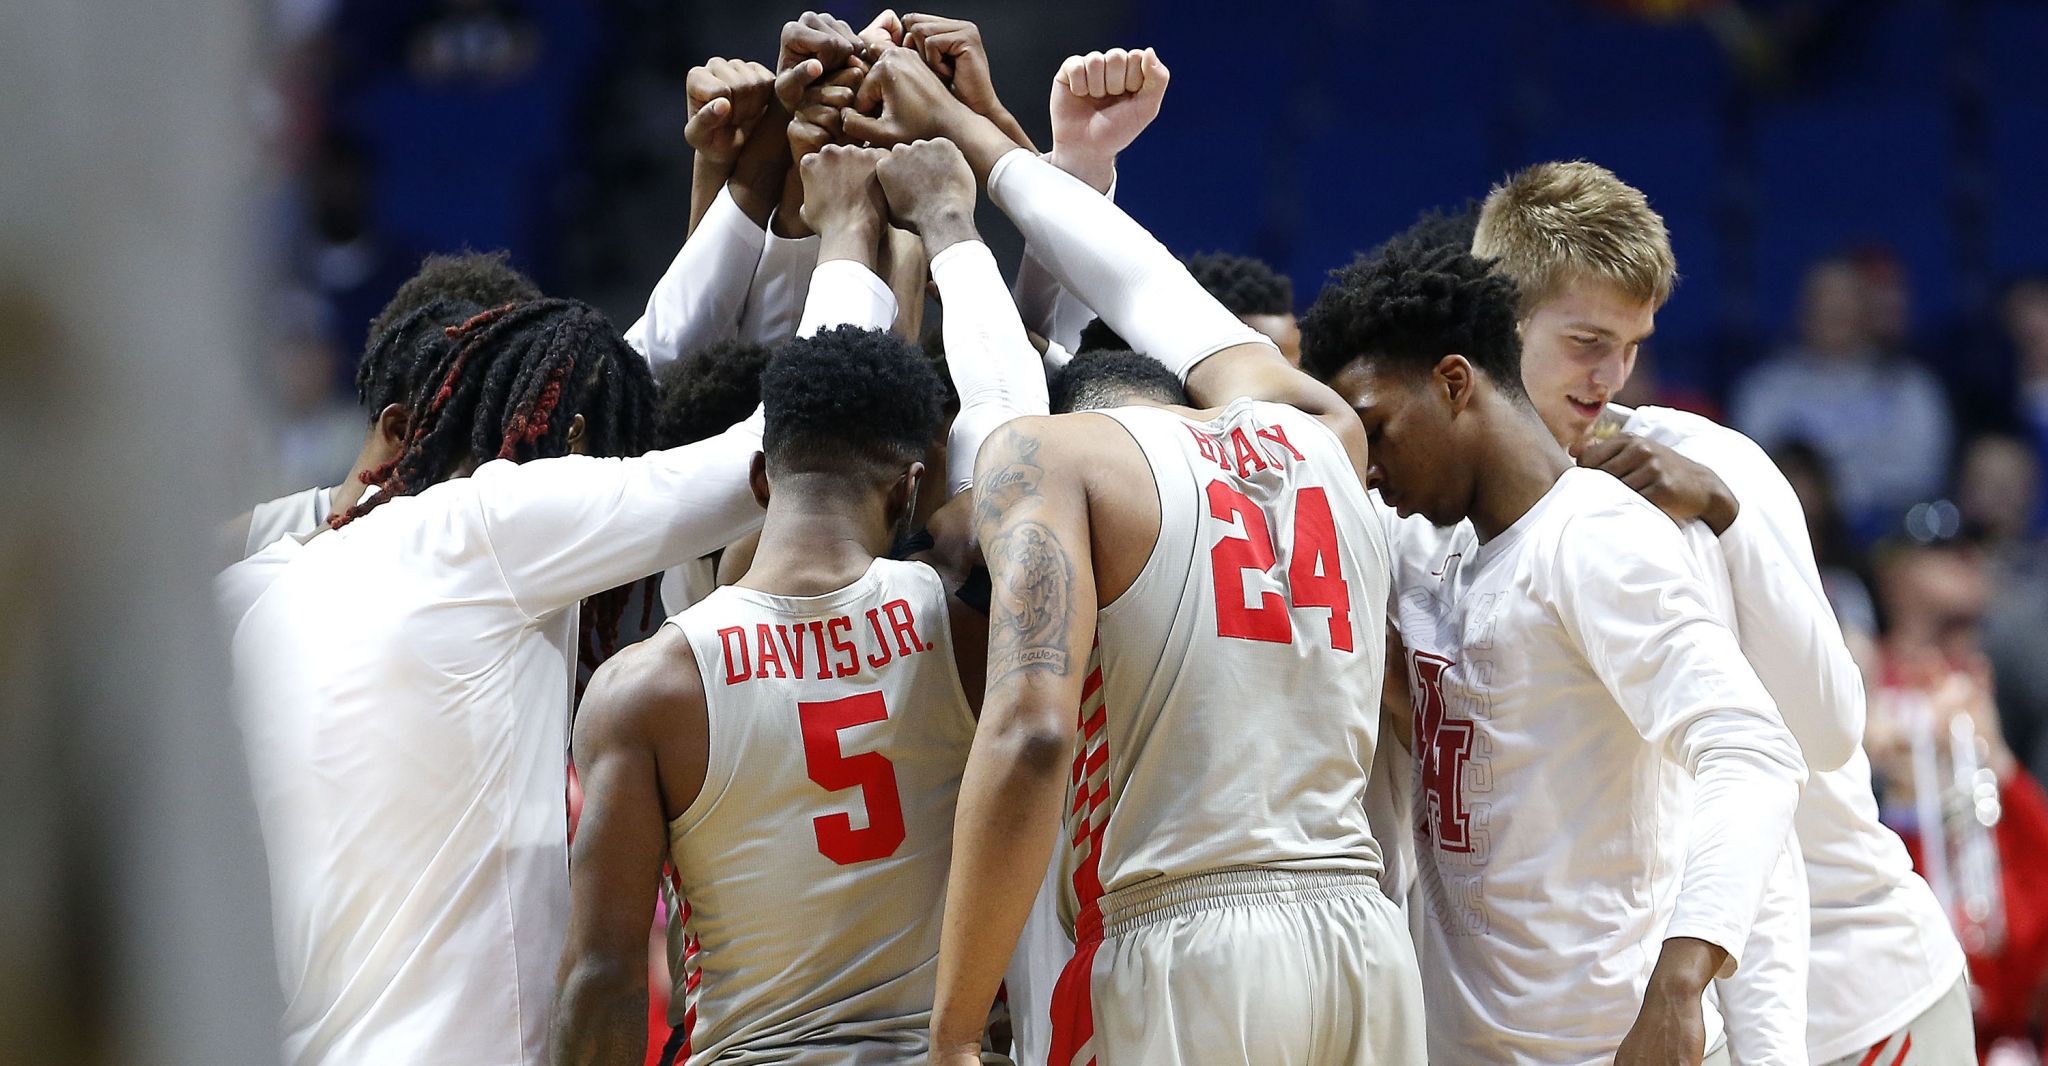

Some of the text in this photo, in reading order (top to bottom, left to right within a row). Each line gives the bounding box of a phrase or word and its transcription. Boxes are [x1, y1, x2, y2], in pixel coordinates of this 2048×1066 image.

[717, 615, 861, 685] DAVIS
[866, 598, 934, 669] JR.
[1206, 479, 1354, 653] 24
[797, 690, 906, 866] 5
